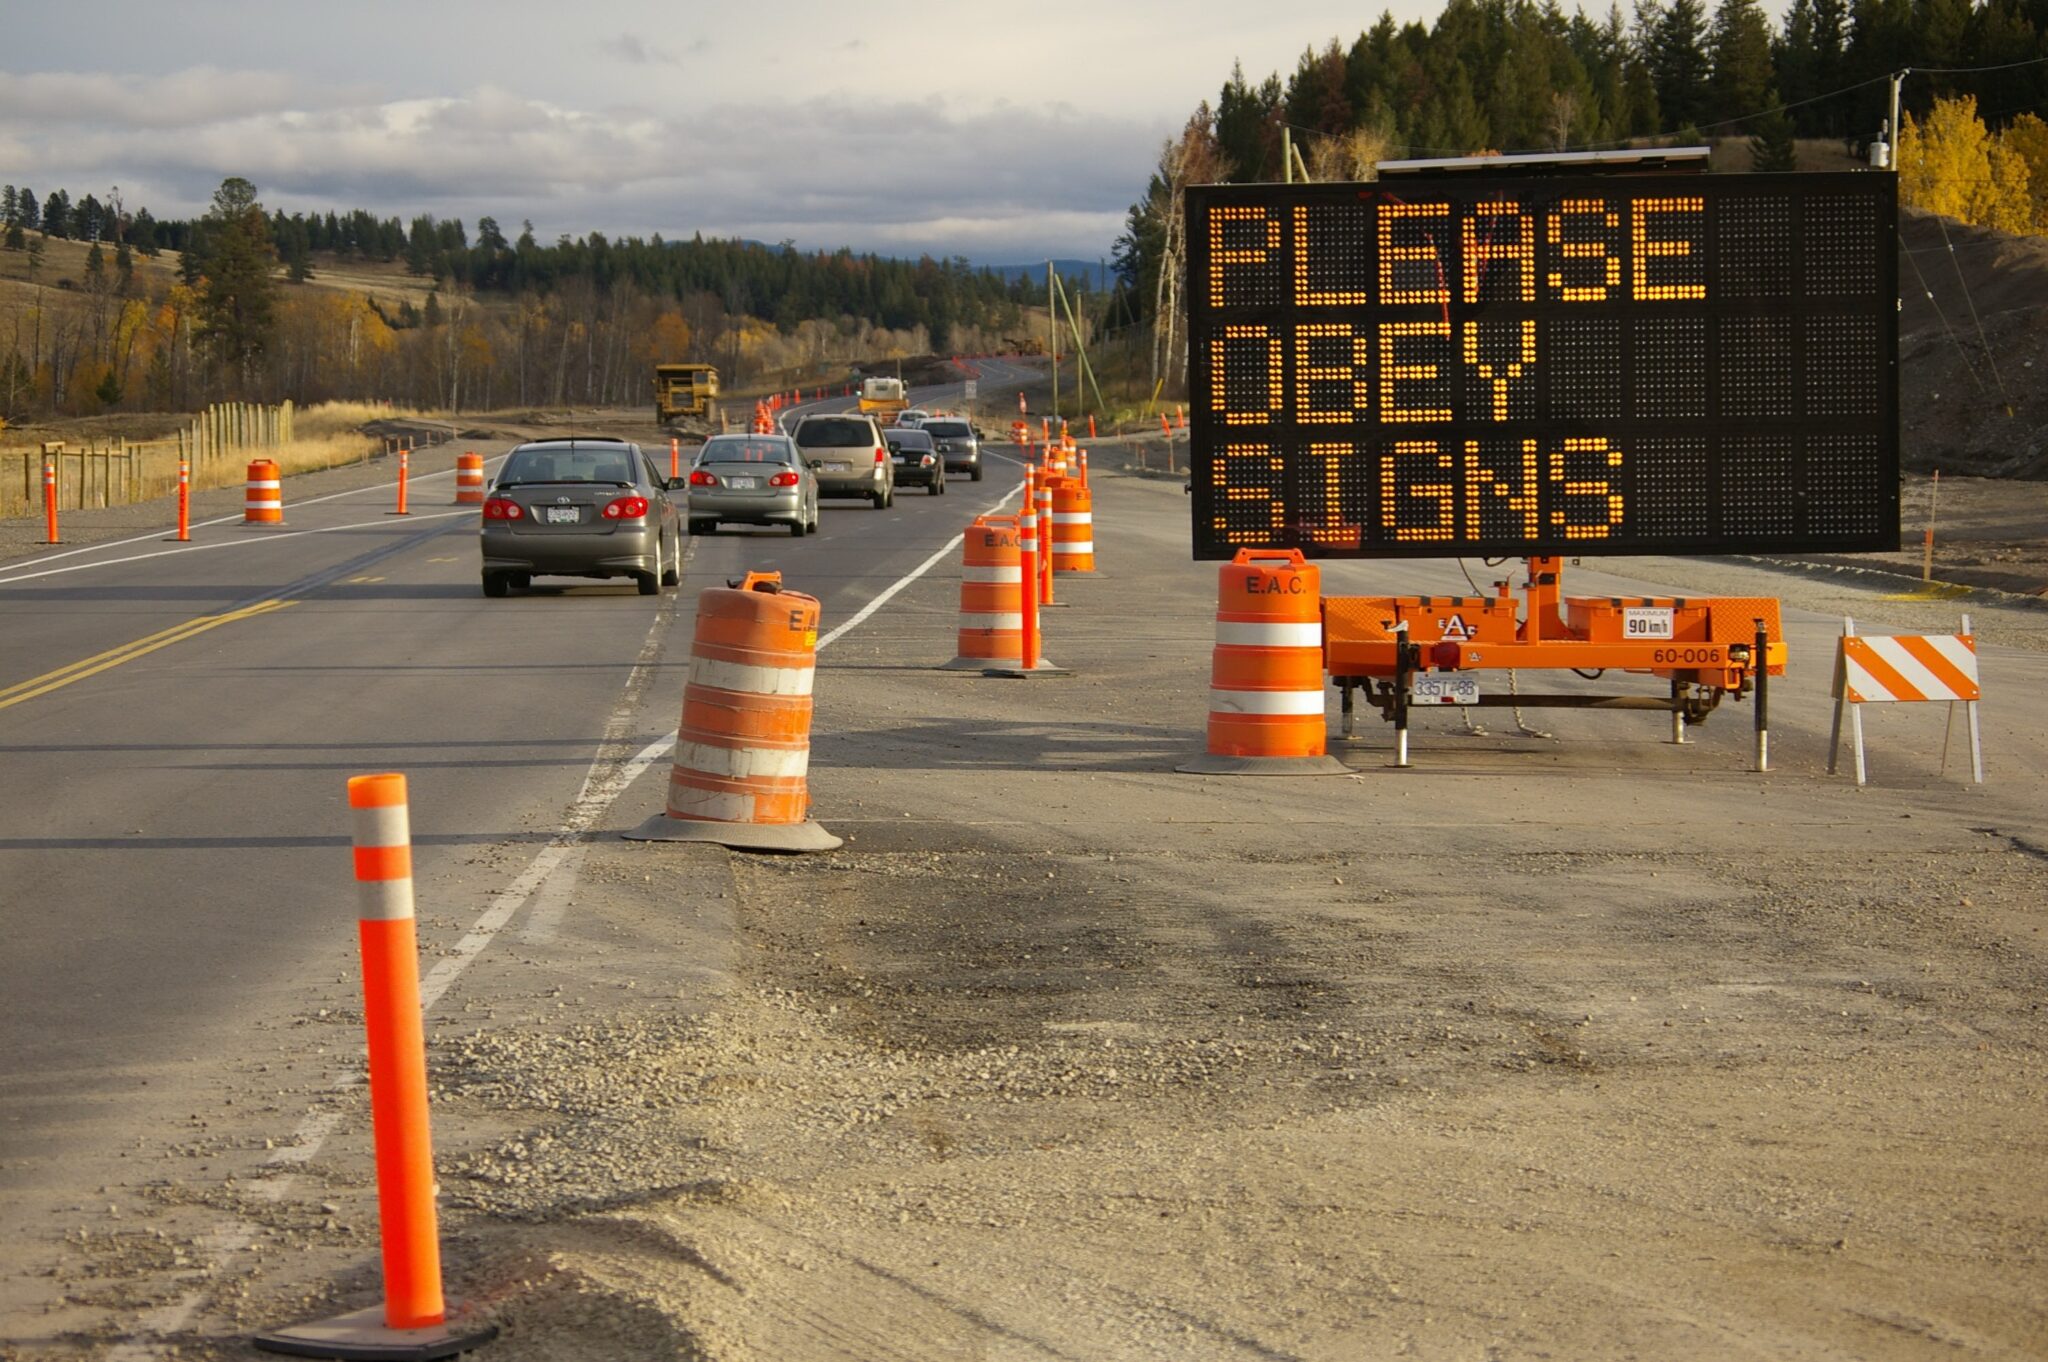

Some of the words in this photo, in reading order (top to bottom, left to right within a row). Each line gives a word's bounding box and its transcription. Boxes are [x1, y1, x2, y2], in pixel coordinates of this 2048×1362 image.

[1209, 197, 1706, 308] PLEASE
[1211, 319, 1537, 425] OBEY
[1212, 437, 1624, 544] SIGNS
[1246, 575, 1307, 595] E.A.C.
[1628, 619, 1647, 633] 90
[1654, 648, 1720, 663] 60-006
